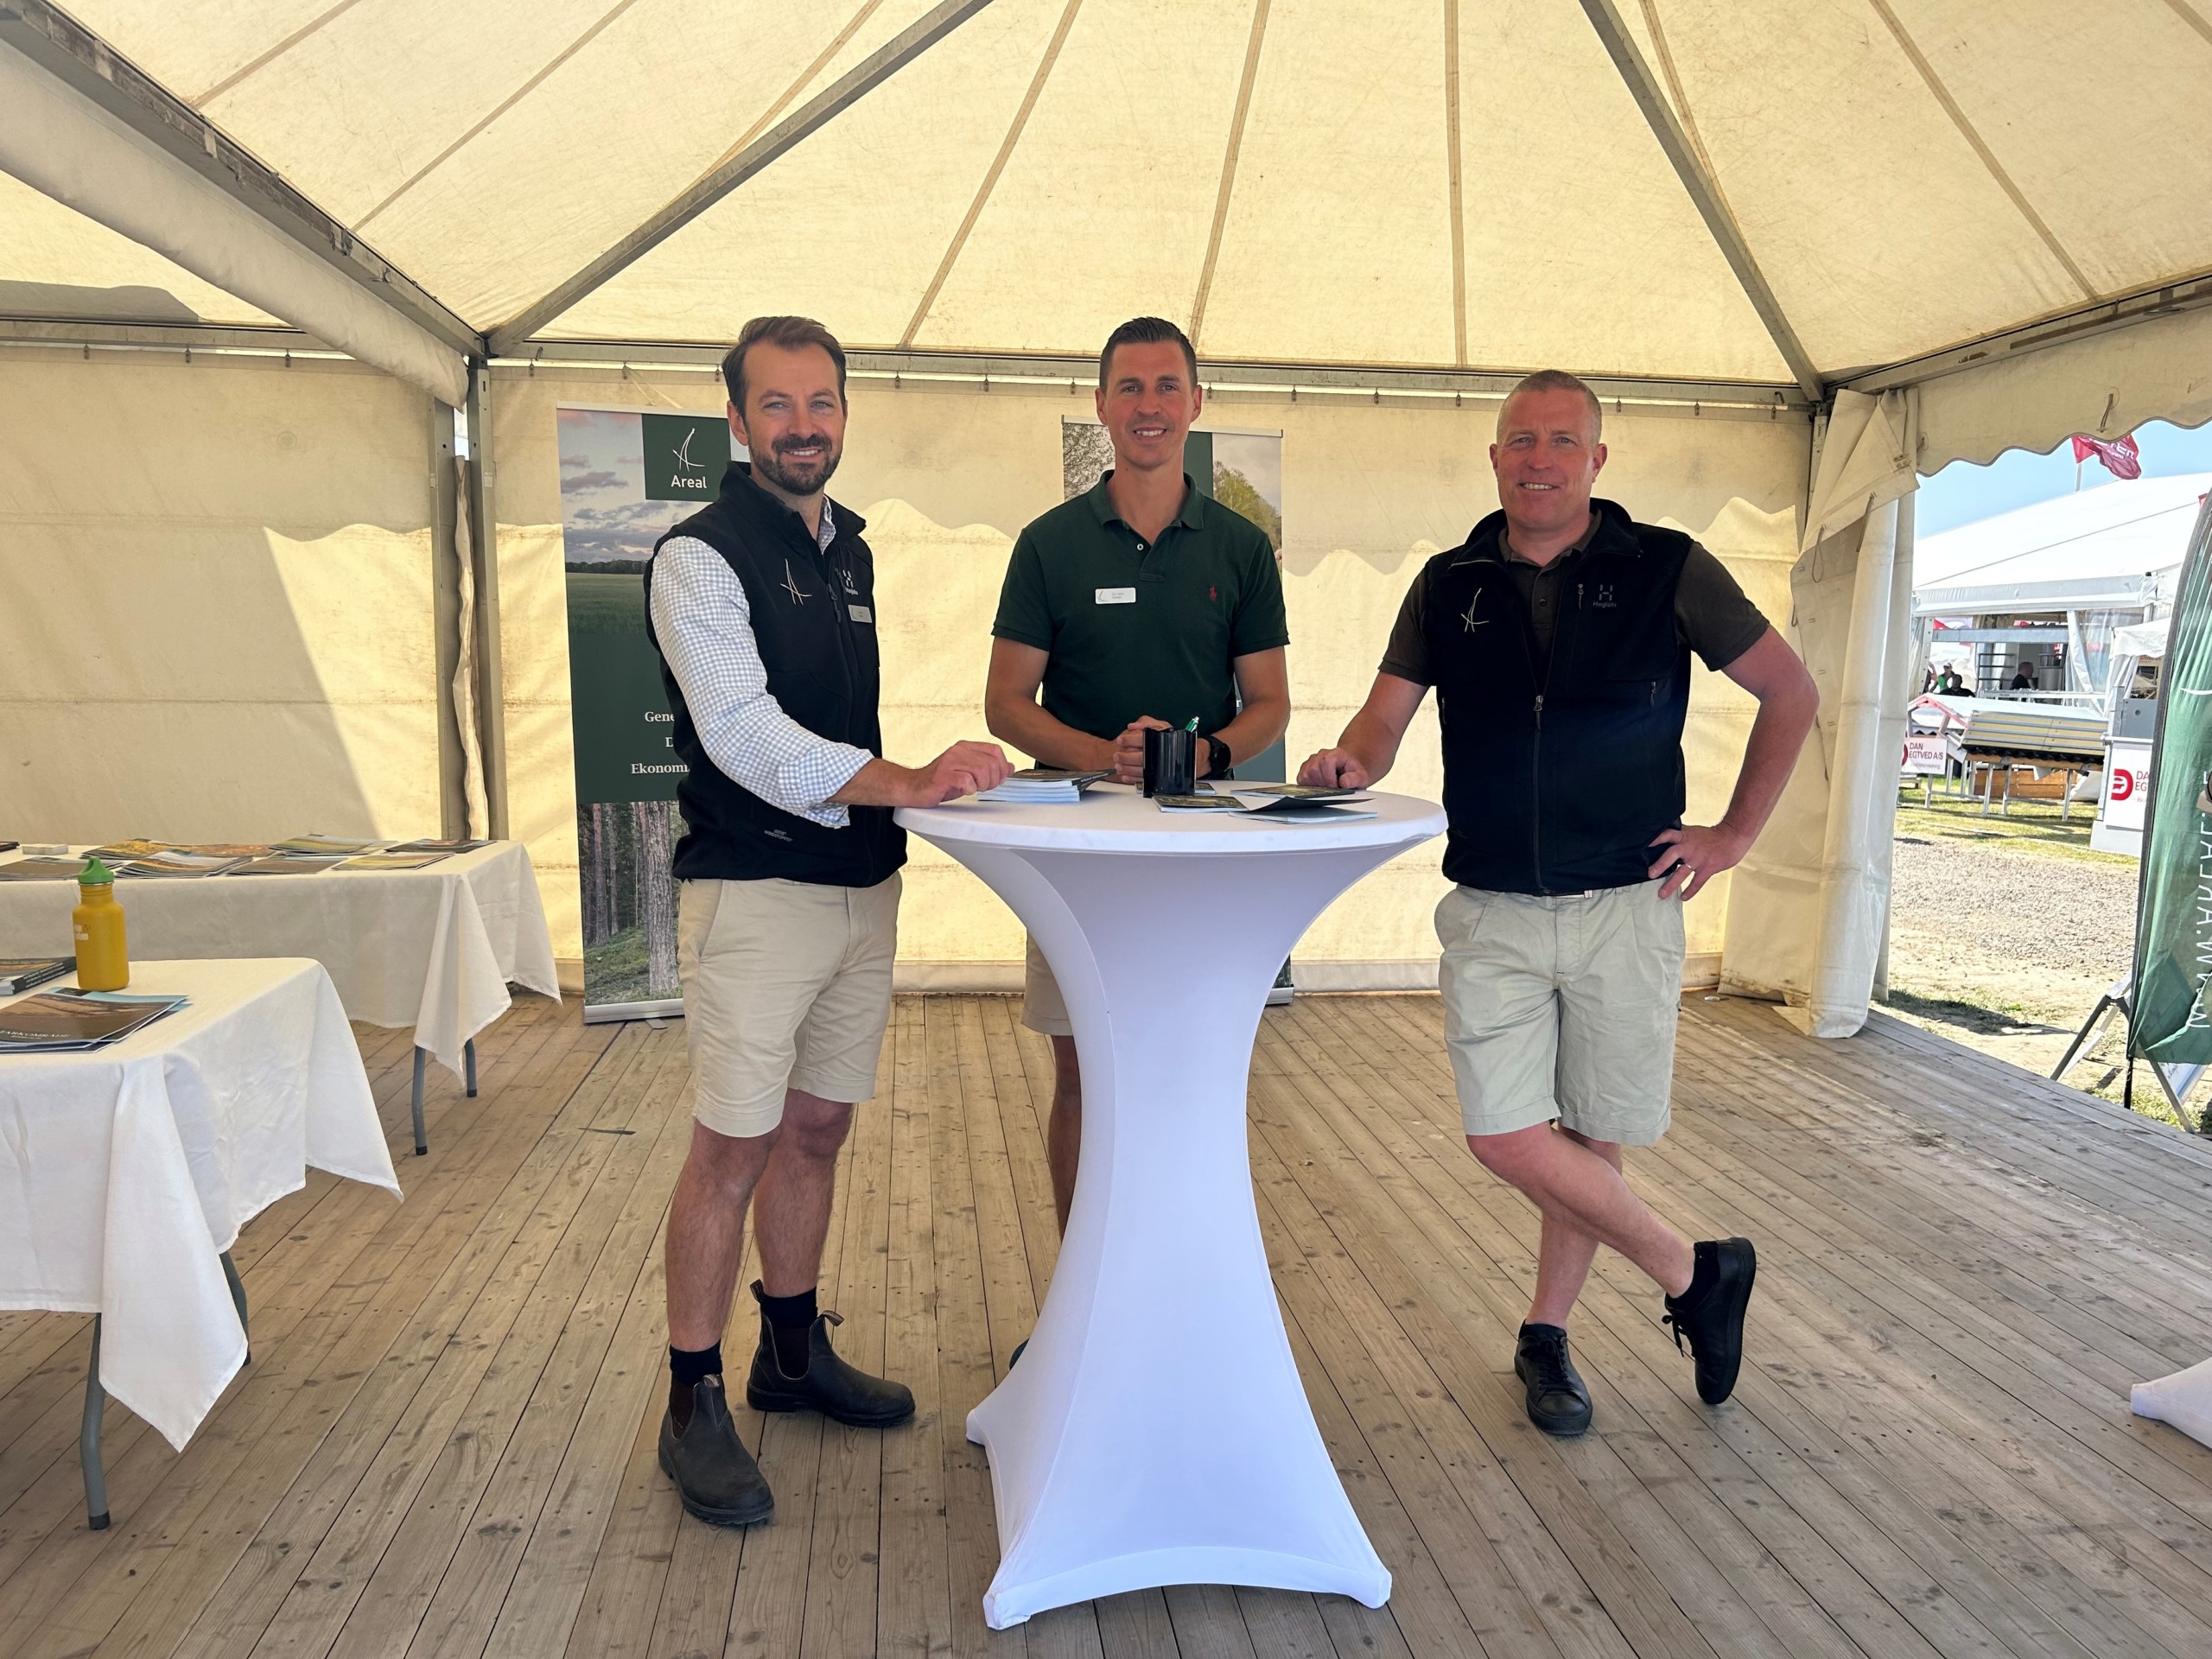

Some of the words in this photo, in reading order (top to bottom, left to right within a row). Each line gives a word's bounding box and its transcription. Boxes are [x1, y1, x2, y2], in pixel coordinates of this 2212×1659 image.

[671, 474, 708, 489] Areal
[644, 711, 675, 722] Gene
[1909, 751, 1933, 760] EGTVED
[631, 762, 690, 774] Ekonomi
[2136, 770, 2150, 781] DA
[2134, 781, 2148, 791] EG
